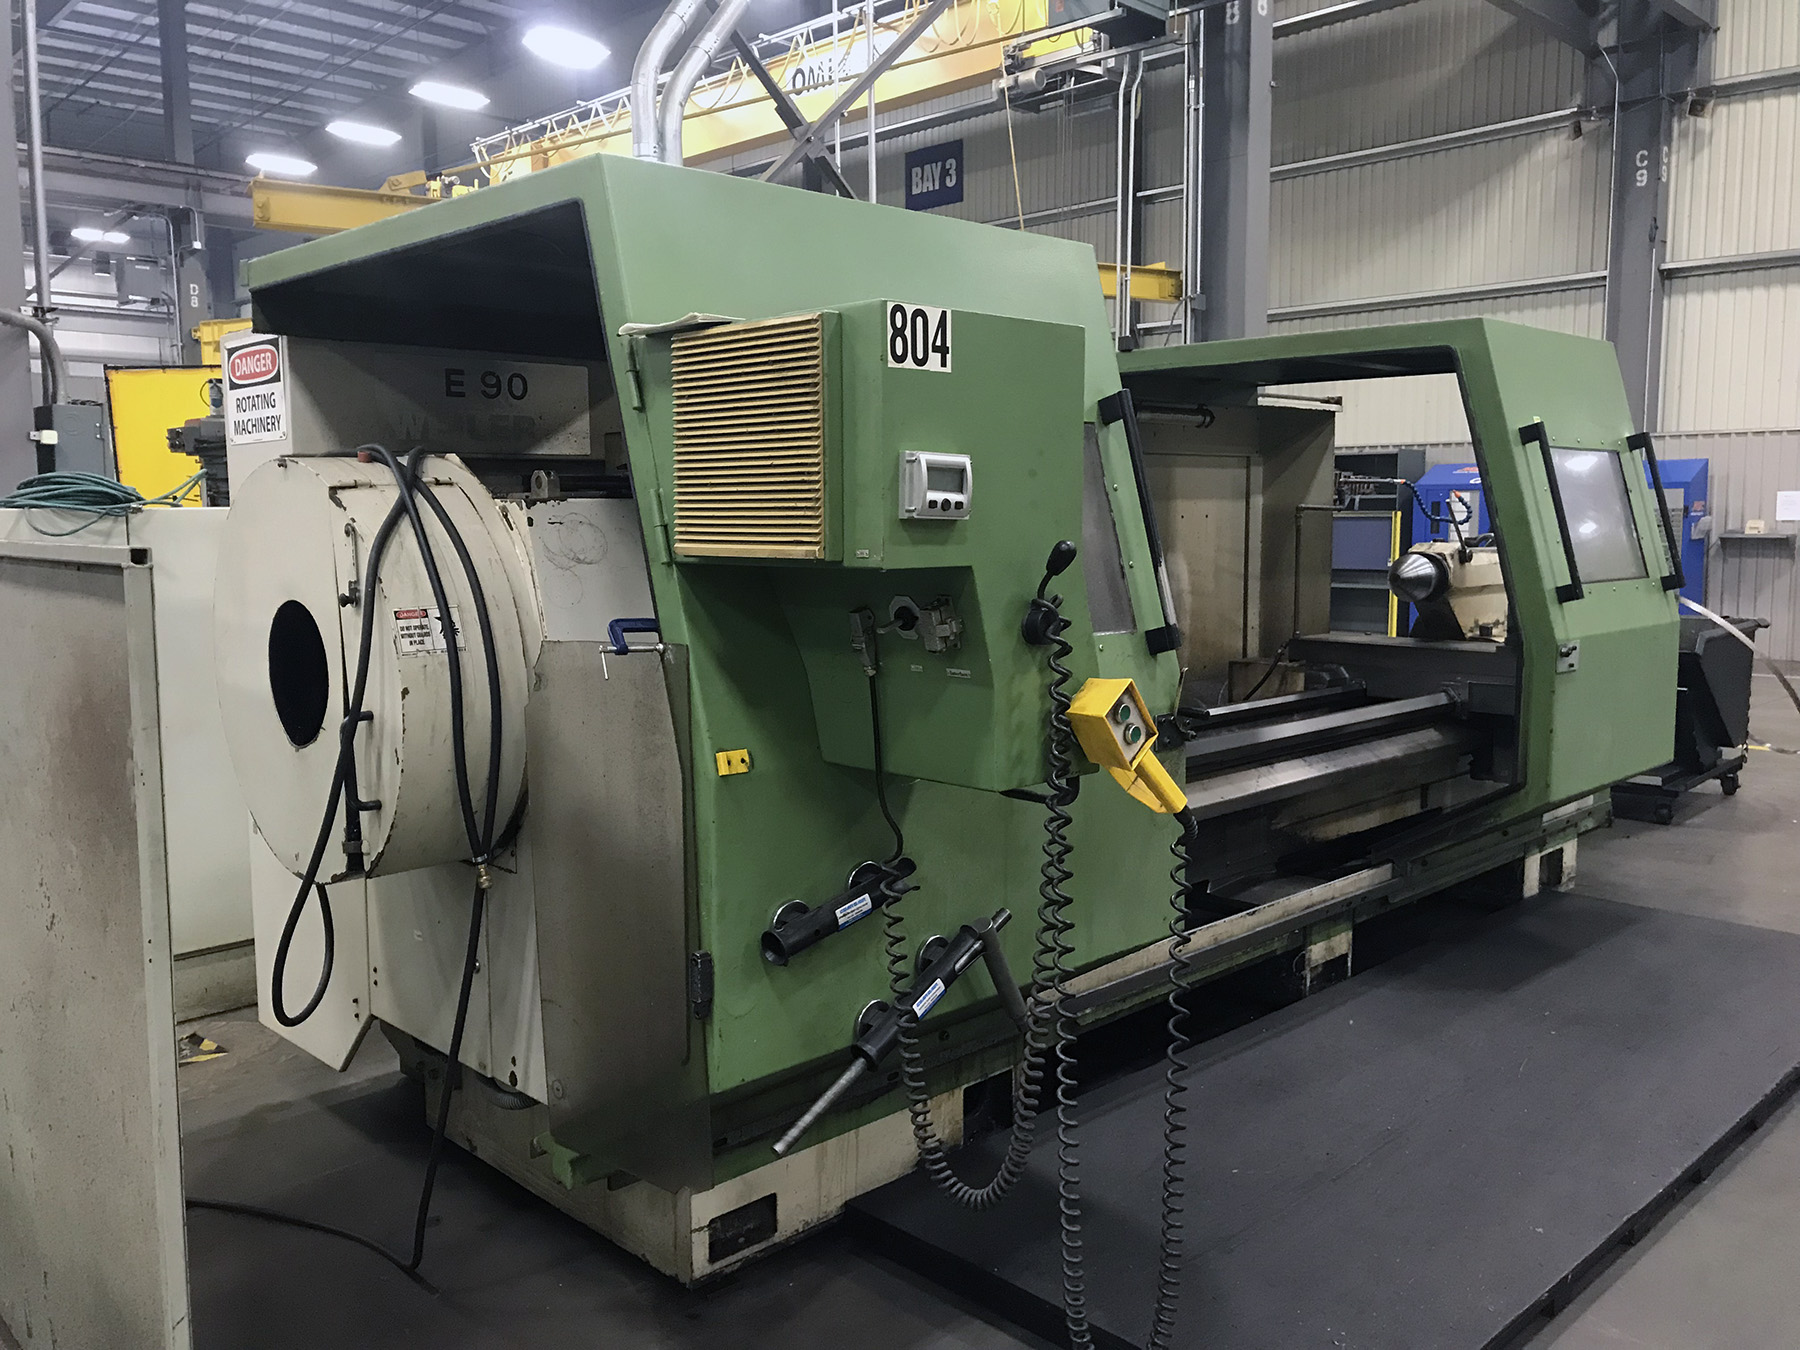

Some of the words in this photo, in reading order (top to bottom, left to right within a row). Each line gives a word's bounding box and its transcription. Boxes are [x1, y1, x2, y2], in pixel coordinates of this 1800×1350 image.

[911, 161, 943, 196] BAY
[945, 158, 957, 188] 3
[1635, 149, 1649, 187] C9
[890, 303, 950, 368] 804
[234, 351, 273, 377] DANGER
[445, 368, 466, 398] E
[480, 371, 528, 401] 90
[235, 391, 276, 414] ROTATING
[233, 414, 281, 436] MACHINERY
